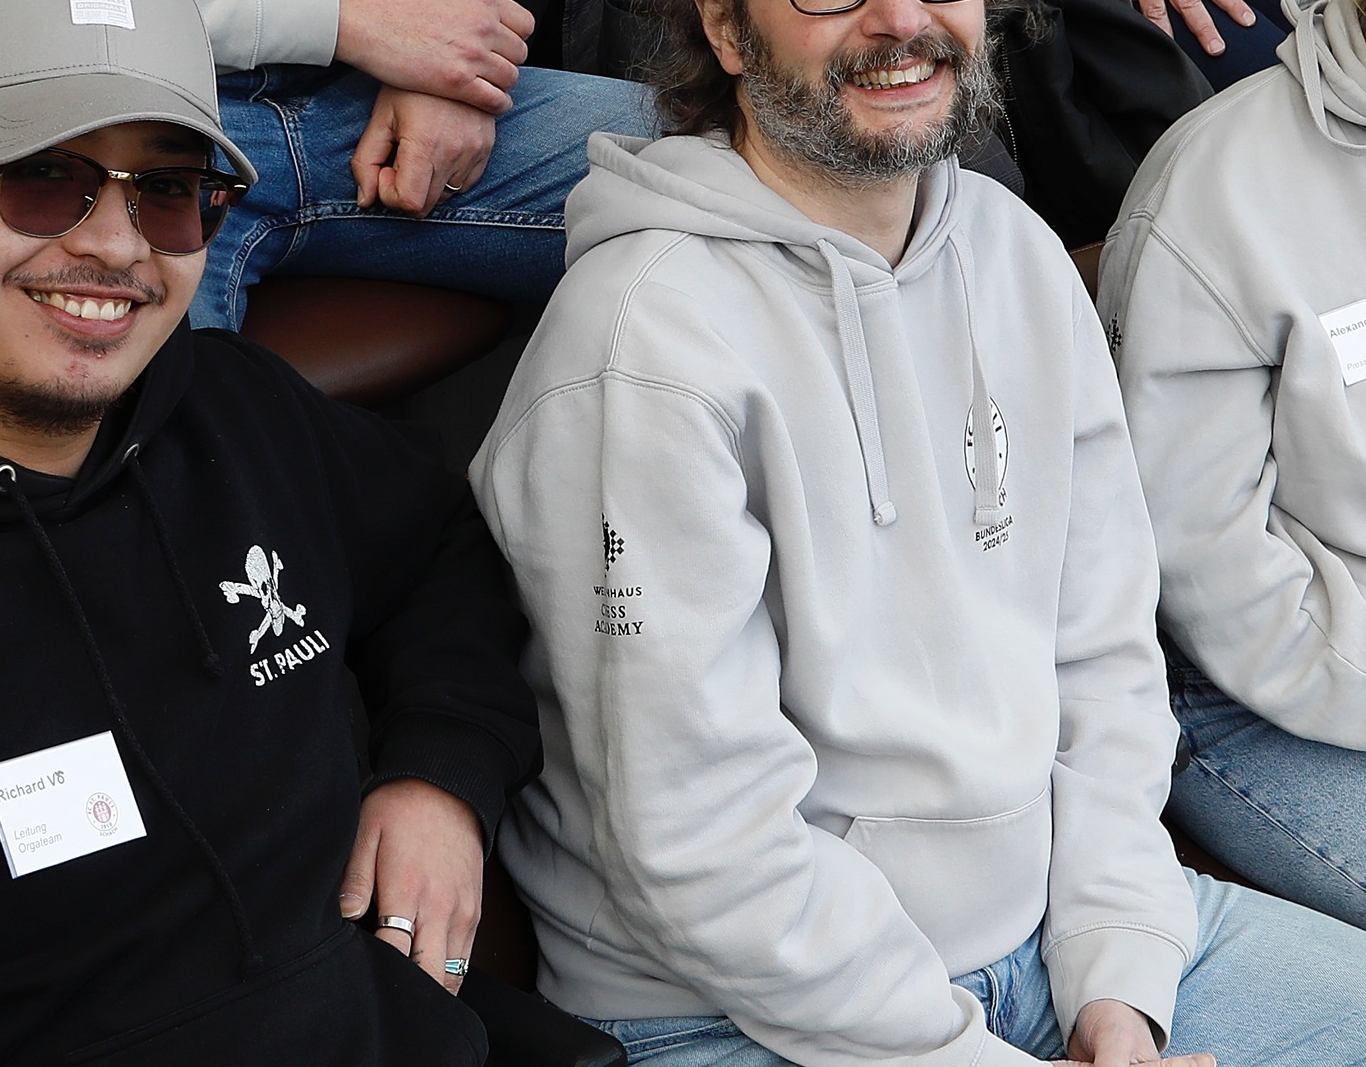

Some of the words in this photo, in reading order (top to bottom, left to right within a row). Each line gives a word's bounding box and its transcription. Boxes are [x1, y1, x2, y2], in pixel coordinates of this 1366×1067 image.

[77, 2, 126, 13] ORIGINALS
[250, 658, 278, 687] ST.
[273, 630, 330, 675] PAULI
[14, 822, 47, 841] Leitung
[18, 833, 63, 853] Orgateam
